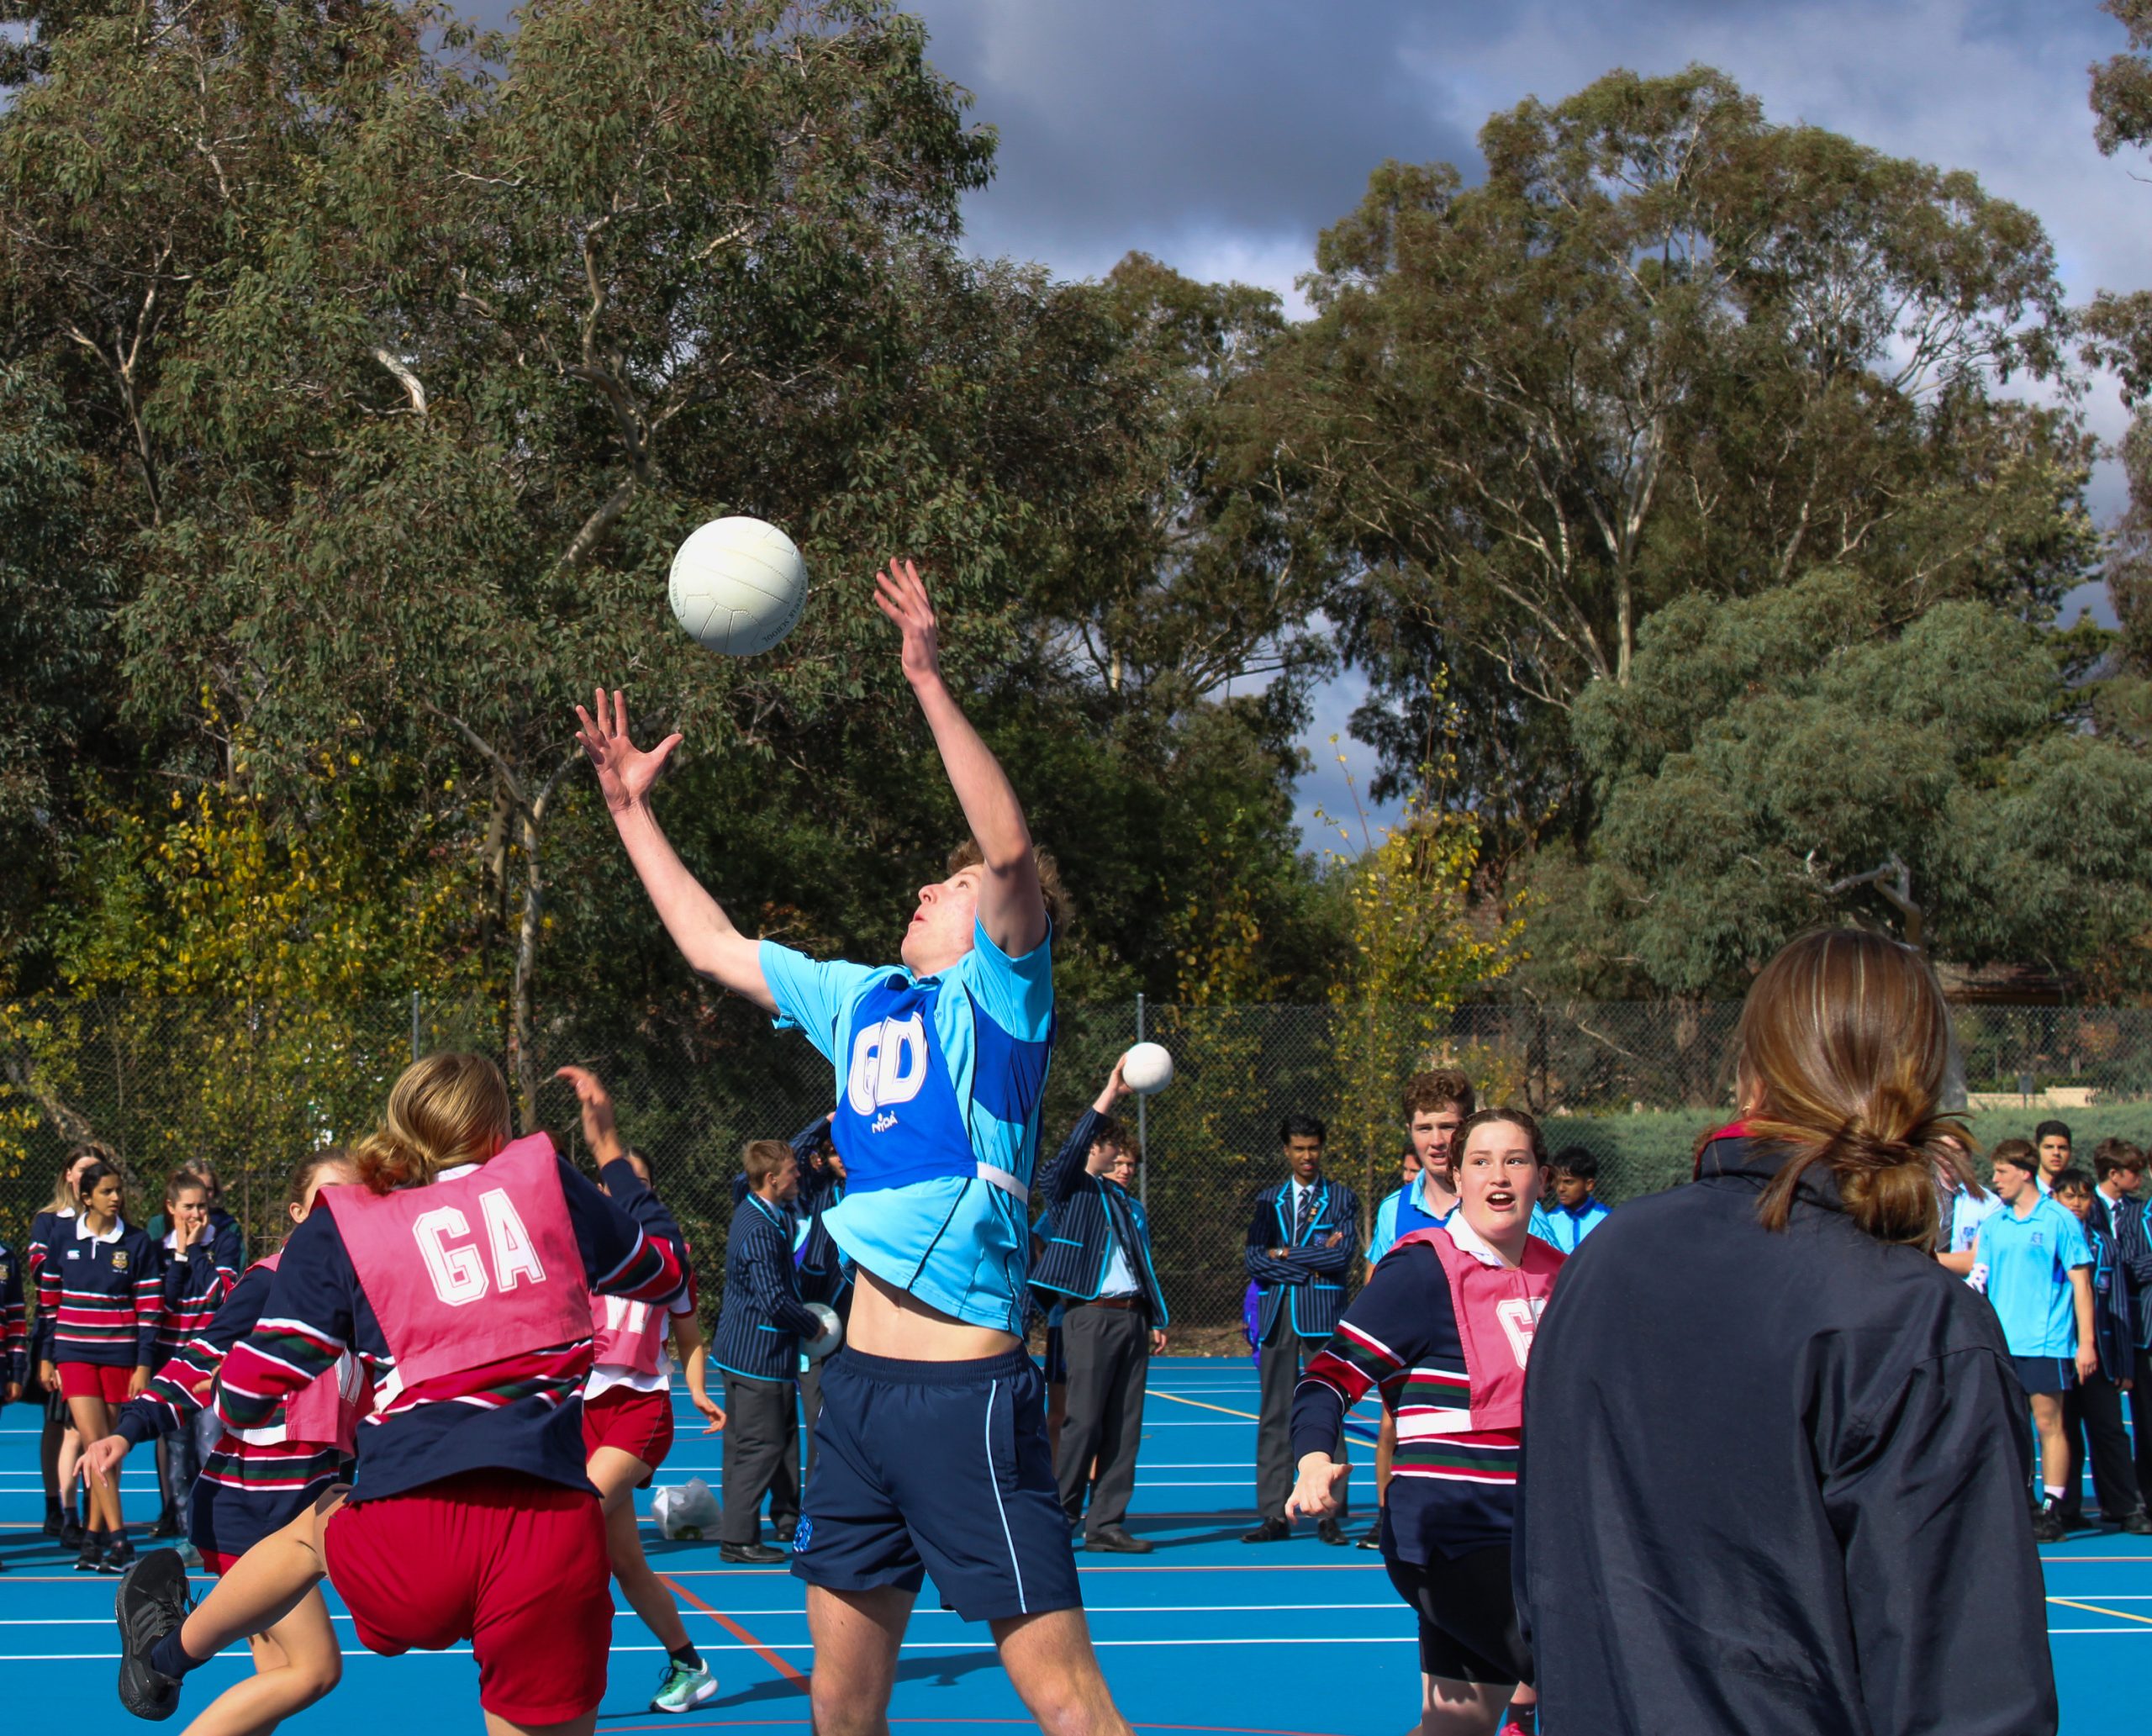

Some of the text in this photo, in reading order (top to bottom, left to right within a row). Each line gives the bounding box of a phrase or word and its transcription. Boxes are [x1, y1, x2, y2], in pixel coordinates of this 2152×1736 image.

[762, 619, 790, 642] SCHOOL
[847, 1011, 927, 1116] GD
[412, 1187, 546, 1307] GA
[1495, 1296, 1548, 1371] G
